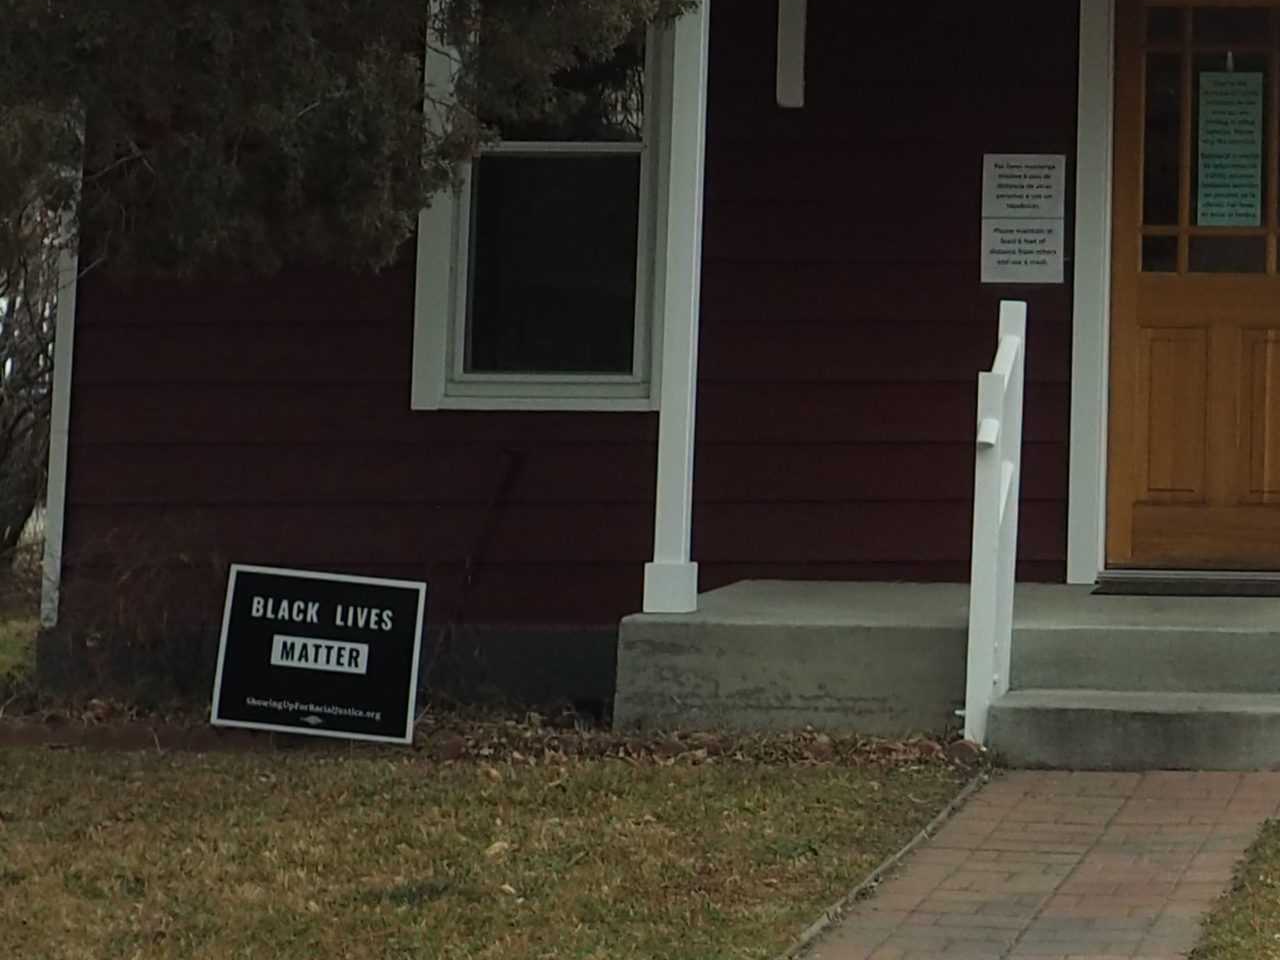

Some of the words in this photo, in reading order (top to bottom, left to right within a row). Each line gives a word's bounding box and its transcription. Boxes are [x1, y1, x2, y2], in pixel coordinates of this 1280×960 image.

[251, 595, 320, 624] BLACK
[335, 604, 394, 632] LIVES
[279, 639, 361, 669] MATTER
